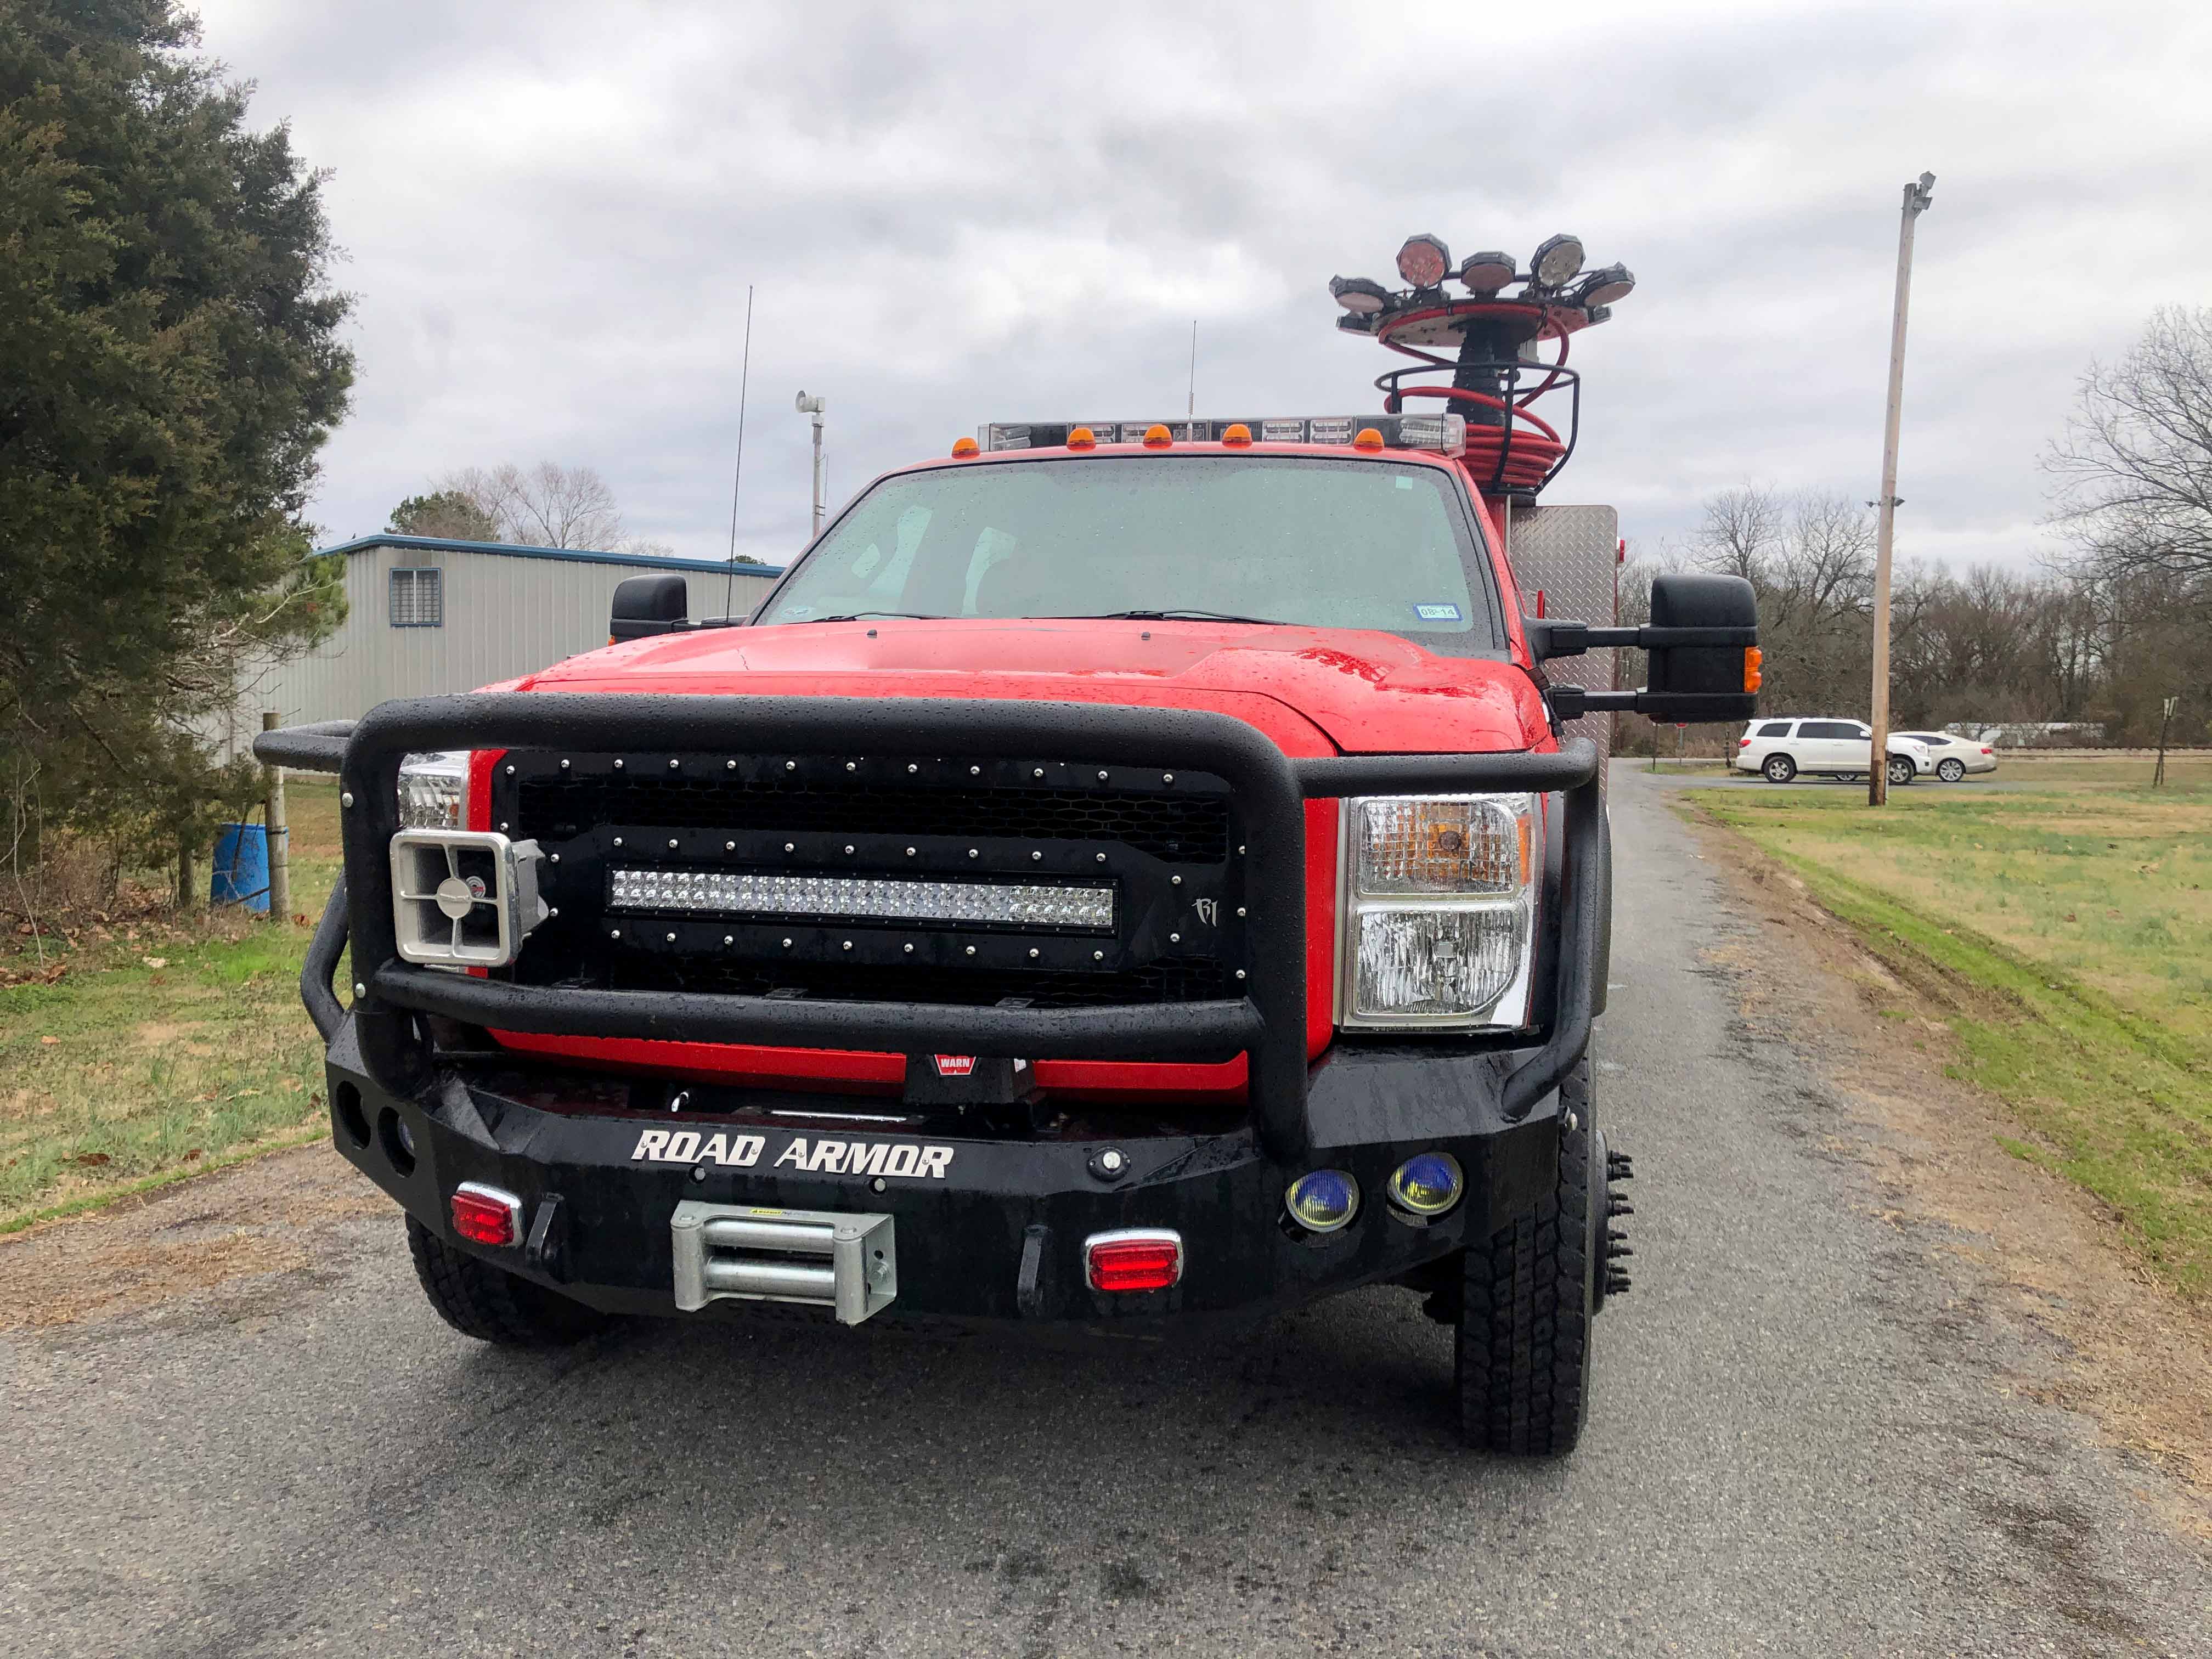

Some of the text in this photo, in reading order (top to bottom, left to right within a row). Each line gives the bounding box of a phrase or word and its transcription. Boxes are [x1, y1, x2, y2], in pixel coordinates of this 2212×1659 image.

[941, 1058, 970, 1068] WARN
[631, 1130, 954, 1178] ROAD ARMOR
